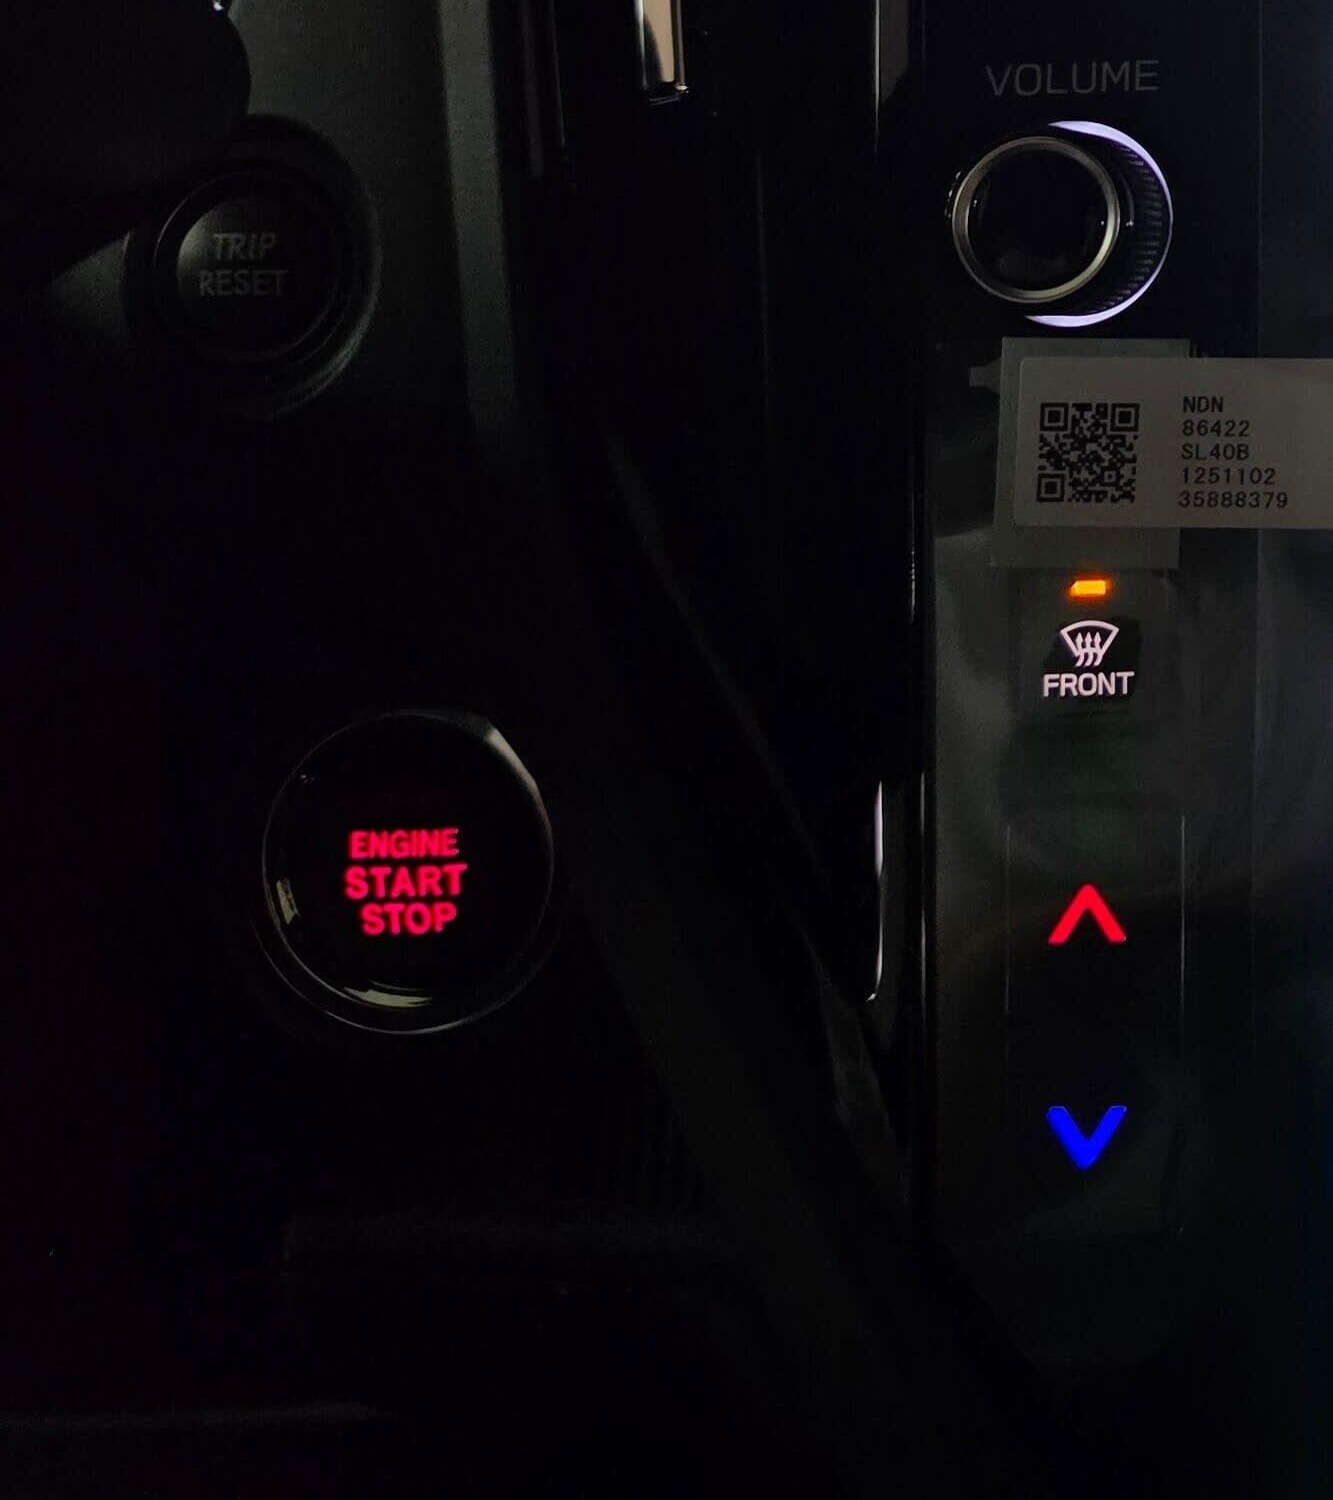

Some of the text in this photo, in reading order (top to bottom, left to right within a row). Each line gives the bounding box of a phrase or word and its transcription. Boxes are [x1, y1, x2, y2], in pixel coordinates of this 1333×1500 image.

[986, 60, 1160, 96] VOLUME
[212, 231, 279, 261] TRIP
[199, 268, 289, 297] RESET
[1183, 396, 1224, 413] NDN
[1182, 420, 1250, 437] 86422
[1181, 443, 1250, 461] SL40B
[1182, 467, 1276, 485] 1251102
[1178, 490, 1289, 509] 35888379
[1042, 670, 1135, 698] FRONT
[349, 826, 461, 860] ENGINE
[344, 863, 468, 900] START
[360, 902, 458, 935] STOP
